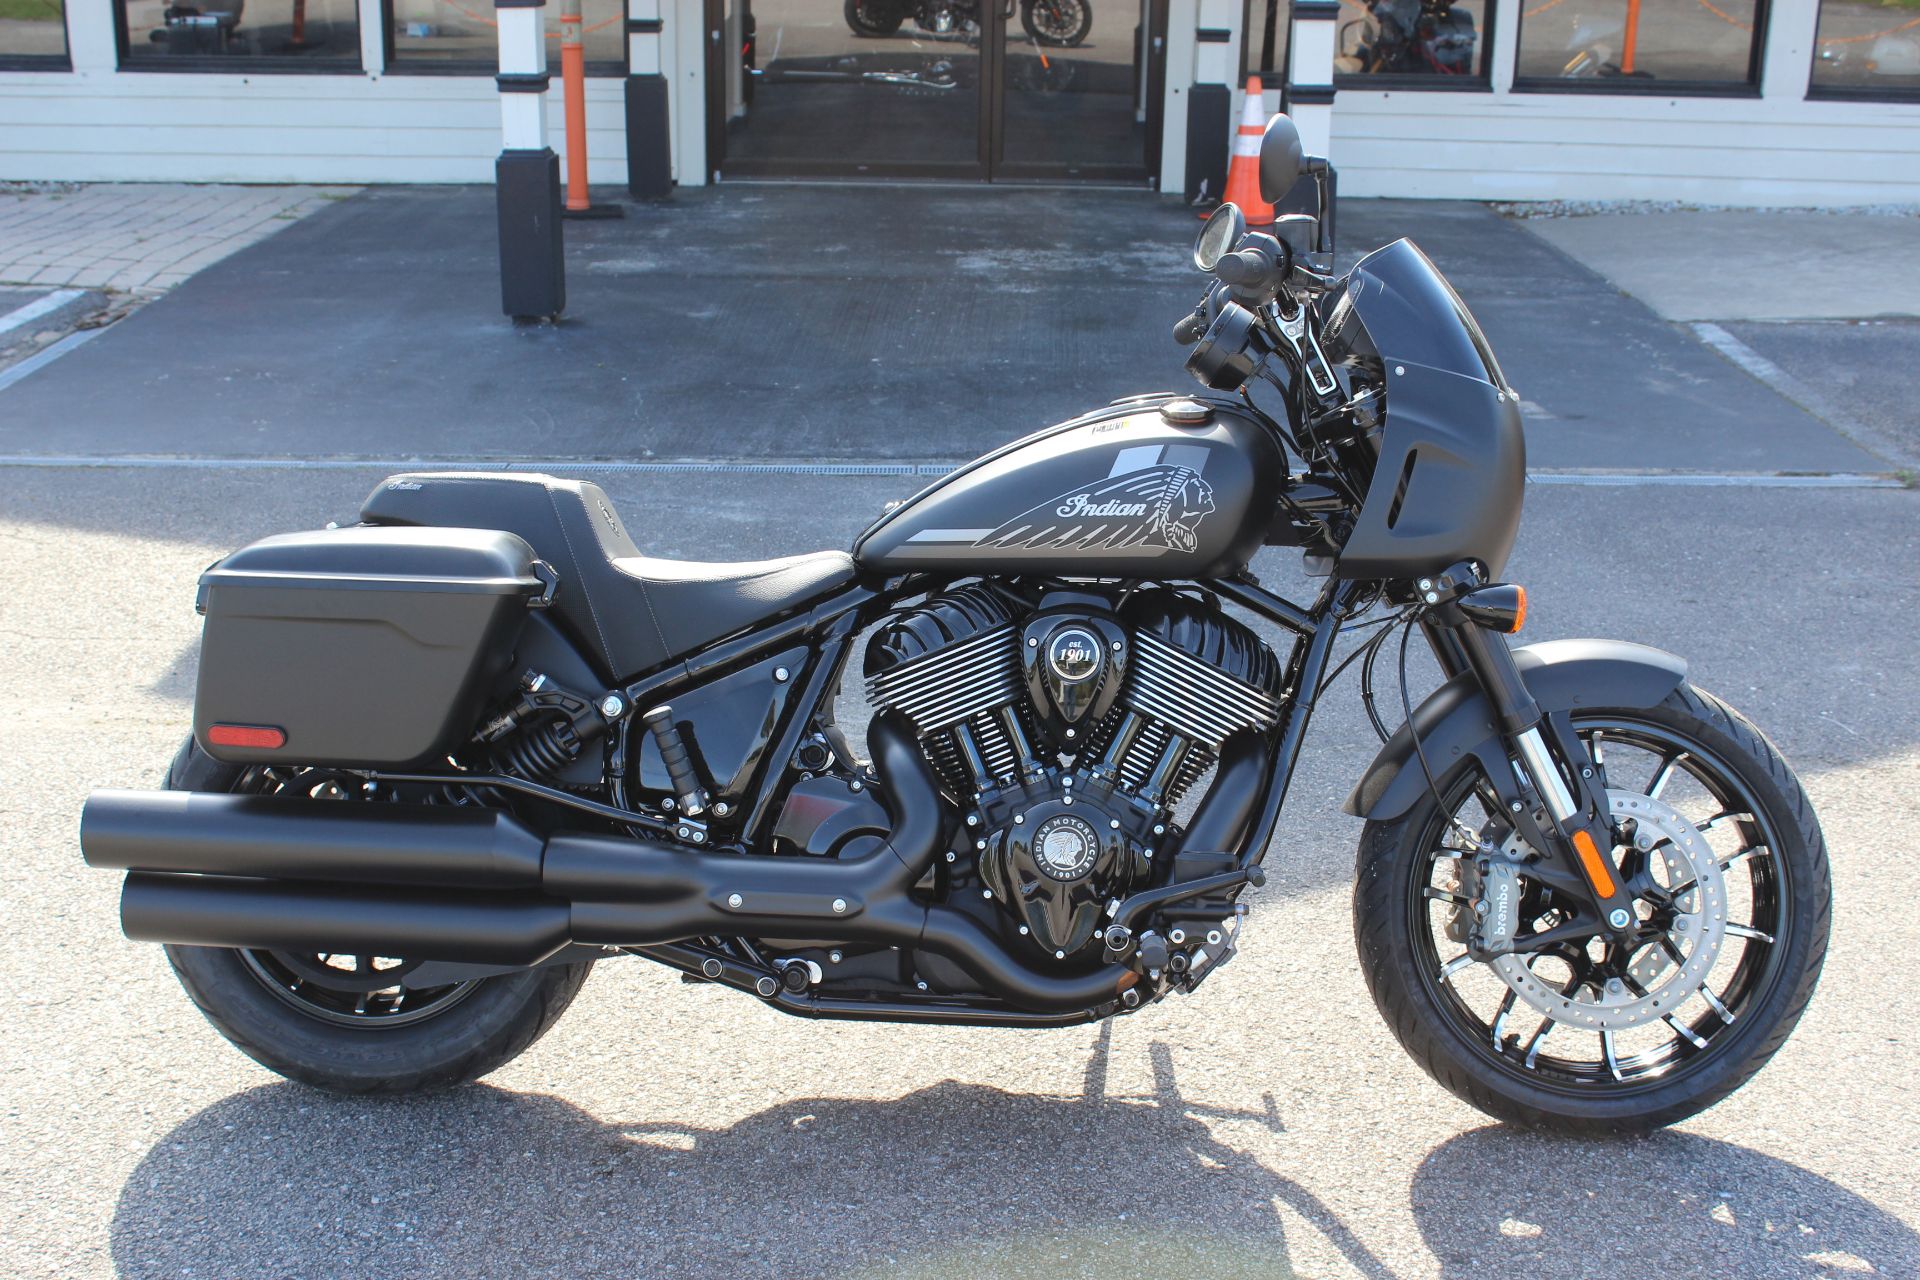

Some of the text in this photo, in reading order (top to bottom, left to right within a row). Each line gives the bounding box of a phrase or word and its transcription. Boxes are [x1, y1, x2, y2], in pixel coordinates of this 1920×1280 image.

[1056, 492, 1147, 518] Indian
[1068, 640, 1083, 648] est.
[1059, 648, 1091, 661] 1901
[1035, 818, 1096, 869] INDIAN MOTORCYCLE
[1053, 870, 1076, 879] 1901
[1494, 884, 1509, 936] brembo
